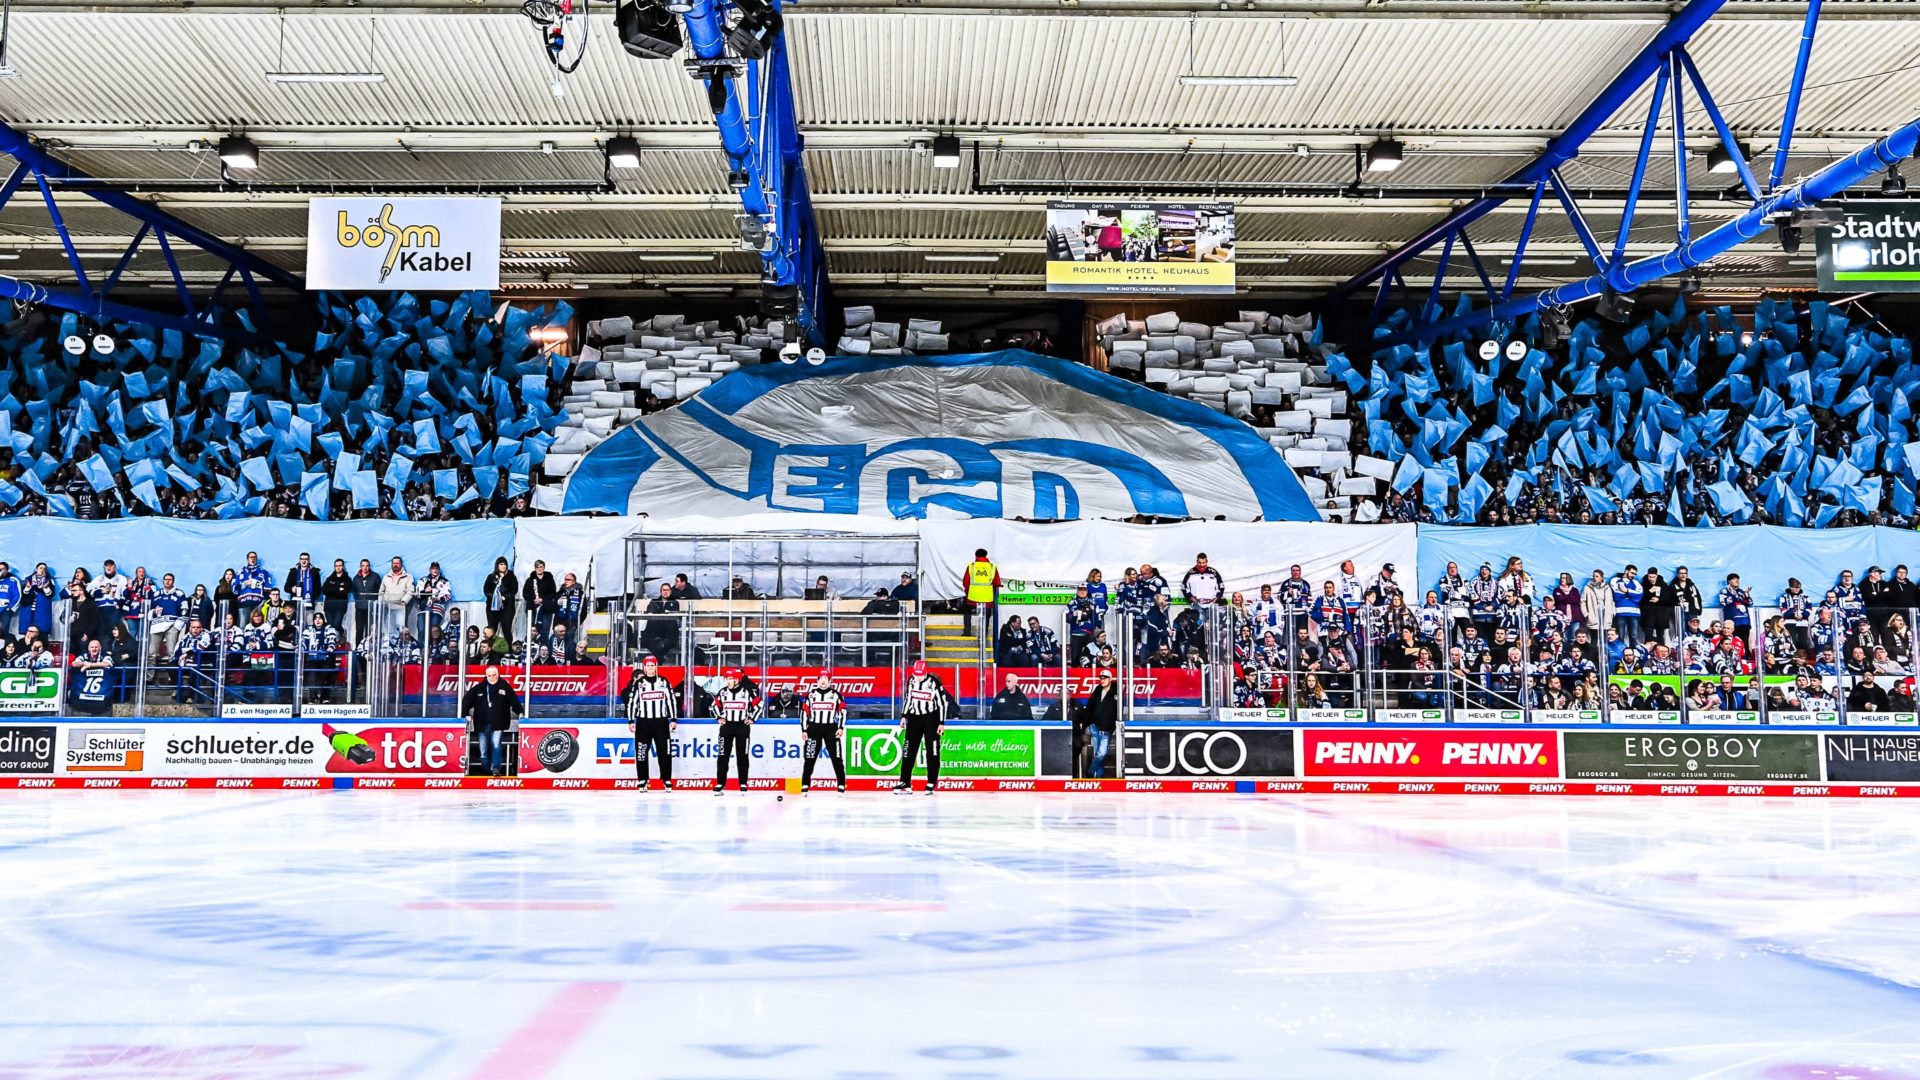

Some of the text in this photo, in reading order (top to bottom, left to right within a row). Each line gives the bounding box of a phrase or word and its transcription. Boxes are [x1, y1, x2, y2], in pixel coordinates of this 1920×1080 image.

[1832, 242, 1920, 265] Irloh
[400, 252, 471, 272] Kabel
[83, 677, 103, 694] 16
[334, 708, 356, 716] Hagen
[89, 738, 145, 750] Schlüter
[167, 735, 314, 754] schlueter.de
[773, 738, 831, 758] Bak
[941, 738, 1029, 756] Heat with efficiency
[1625, 737, 1762, 759] ERGOBOY
[1315, 741, 1548, 765] PENNY. PENNY.
[1828, 738, 1870, 762] NH
[67, 751, 123, 764] Systems
[1874, 750, 1920, 762] HUNE
[166, 757, 207, 766] Nachhaltig
[240, 757, 286, 766] Unabhängig
[940, 759, 1030, 769] ELEKTROWÄRMETECHNIK
[18, 779, 54, 787] PENNY.
[84, 779, 121, 787] PENNY.
[151, 779, 188, 787] PENNY.
[216, 779, 253, 787] PENNY.
[283, 779, 320, 787] PENNY.
[359, 779, 395, 787] PENNY.
[425, 779, 462, 787] PENNY.
[487, 779, 524, 787] PENNY.
[553, 779, 590, 787] PENNY.
[1192, 782, 1229, 790] PENNY.
[1333, 783, 1370, 791] PENNY.
[1464, 784, 1501, 792] PENNY.
[1529, 784, 1566, 792] PENNY.
[1728, 786, 1764, 794] PENNY.
[1860, 787, 1897, 795] PENNY.
